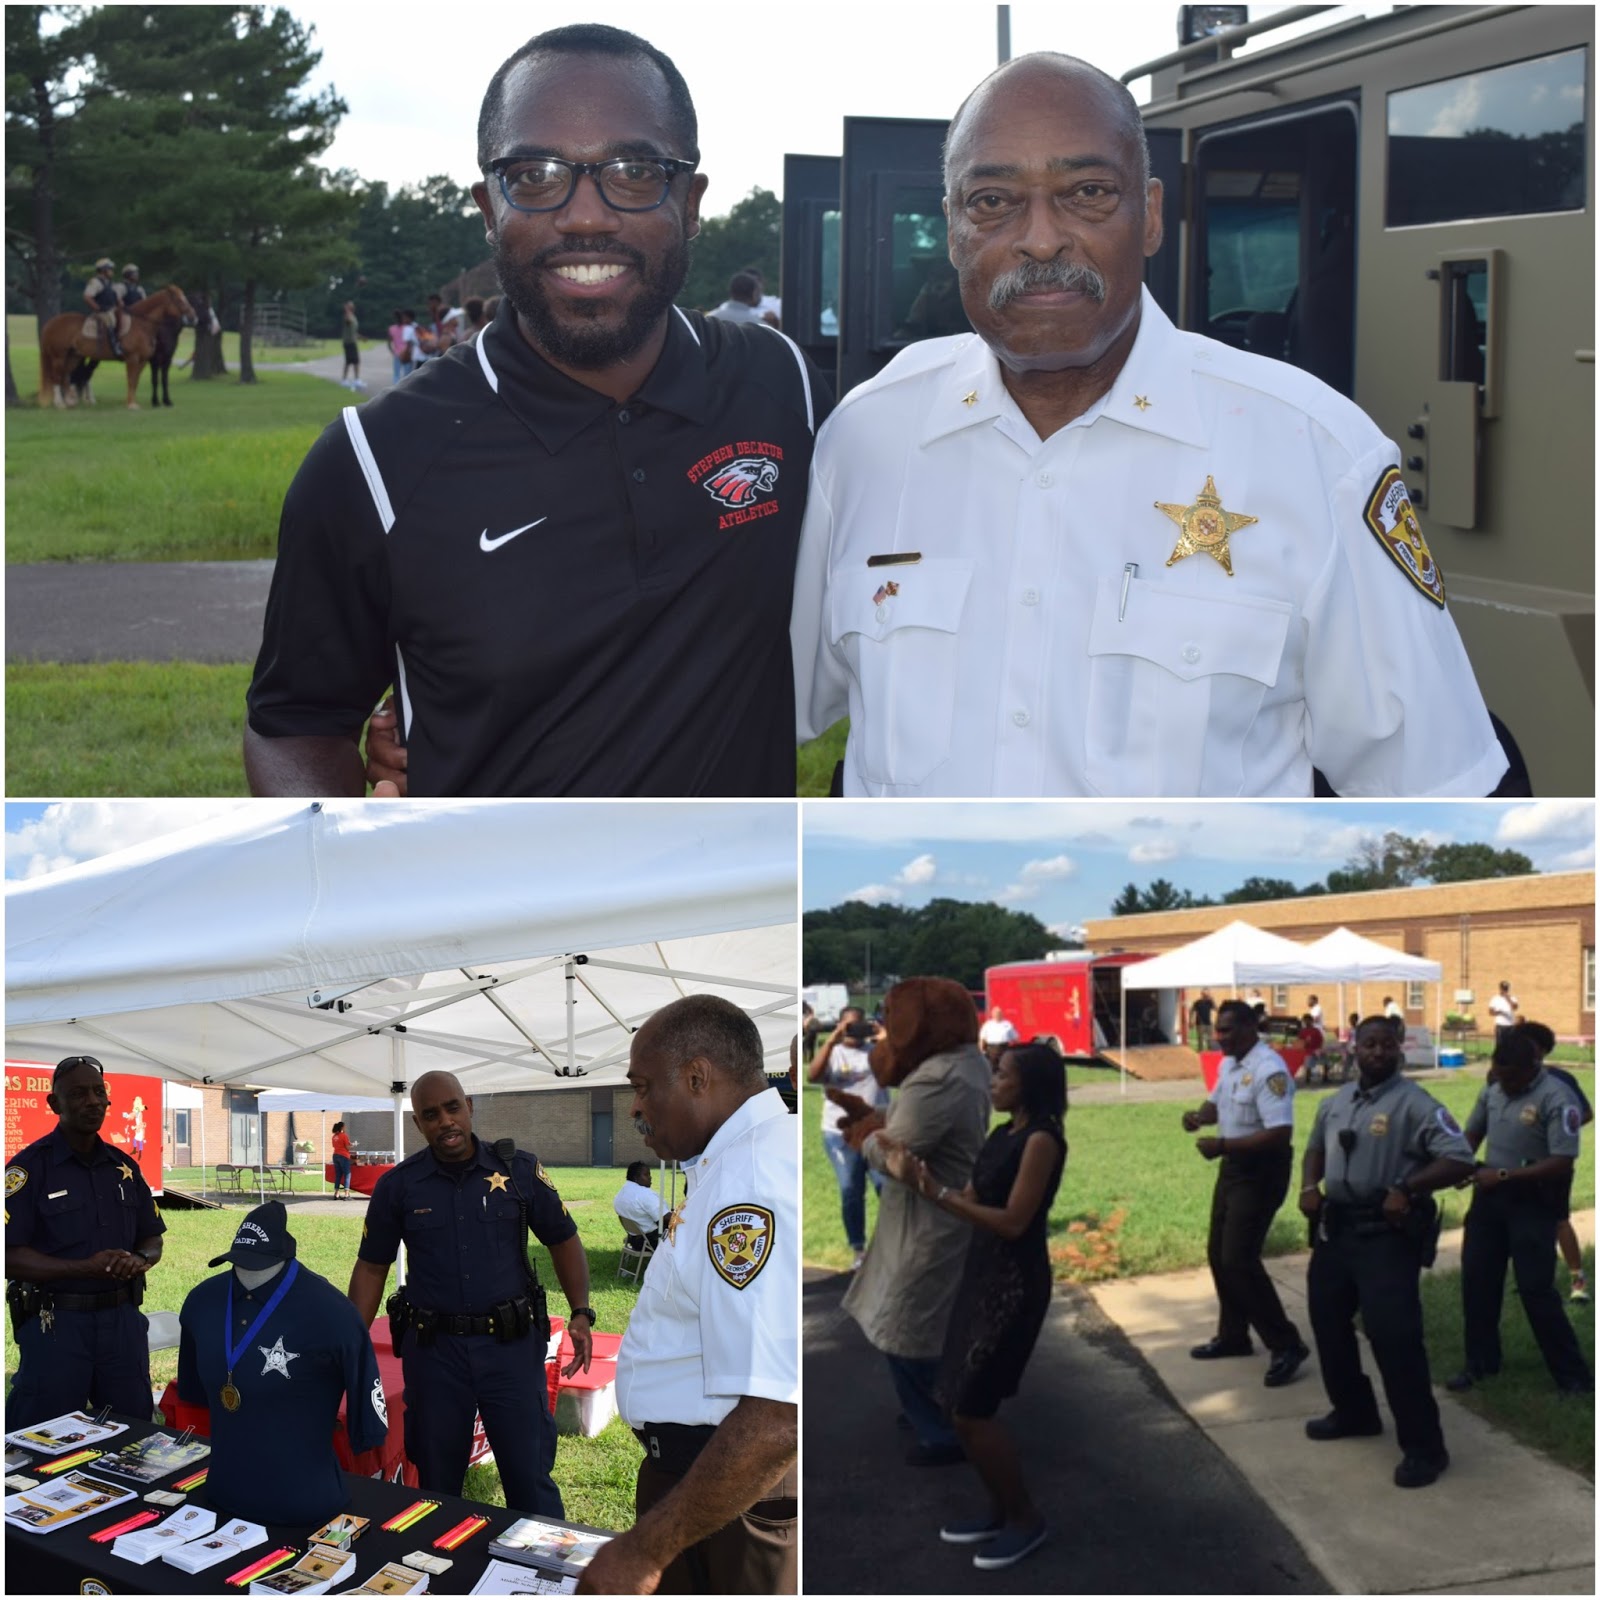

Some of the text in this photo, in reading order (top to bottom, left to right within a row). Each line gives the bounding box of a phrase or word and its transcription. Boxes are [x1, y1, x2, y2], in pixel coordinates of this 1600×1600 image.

[686, 441, 784, 484] STEPHEN DECATUR
[718, 500, 780, 529] ATHLETICS
[719, 1214, 754, 1229] SHERIFF
[235, 1238, 258, 1246] CADET
[714, 1244, 724, 1263] PRINCE
[754, 1238, 764, 1258] COUNTY
